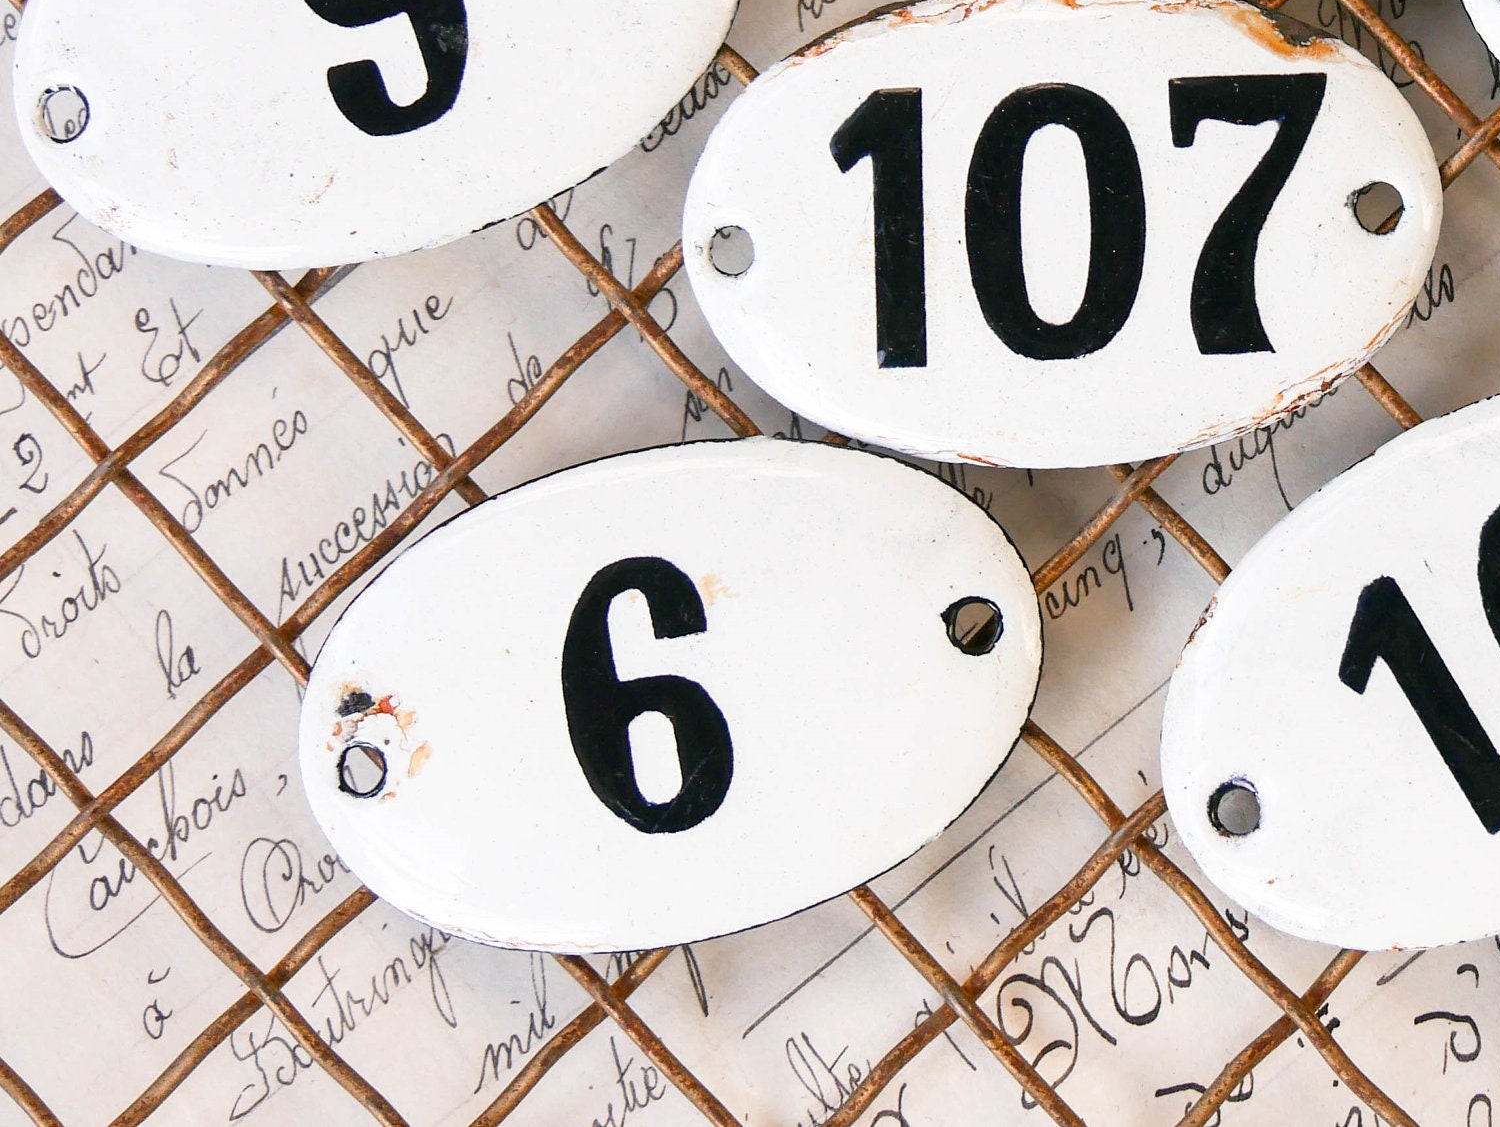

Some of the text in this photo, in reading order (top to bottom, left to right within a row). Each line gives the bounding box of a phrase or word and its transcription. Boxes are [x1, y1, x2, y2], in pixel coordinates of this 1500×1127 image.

[830, 73, 1327, 368] 107
[155, 609, 201, 700] la
[562, 556, 734, 834] 6
